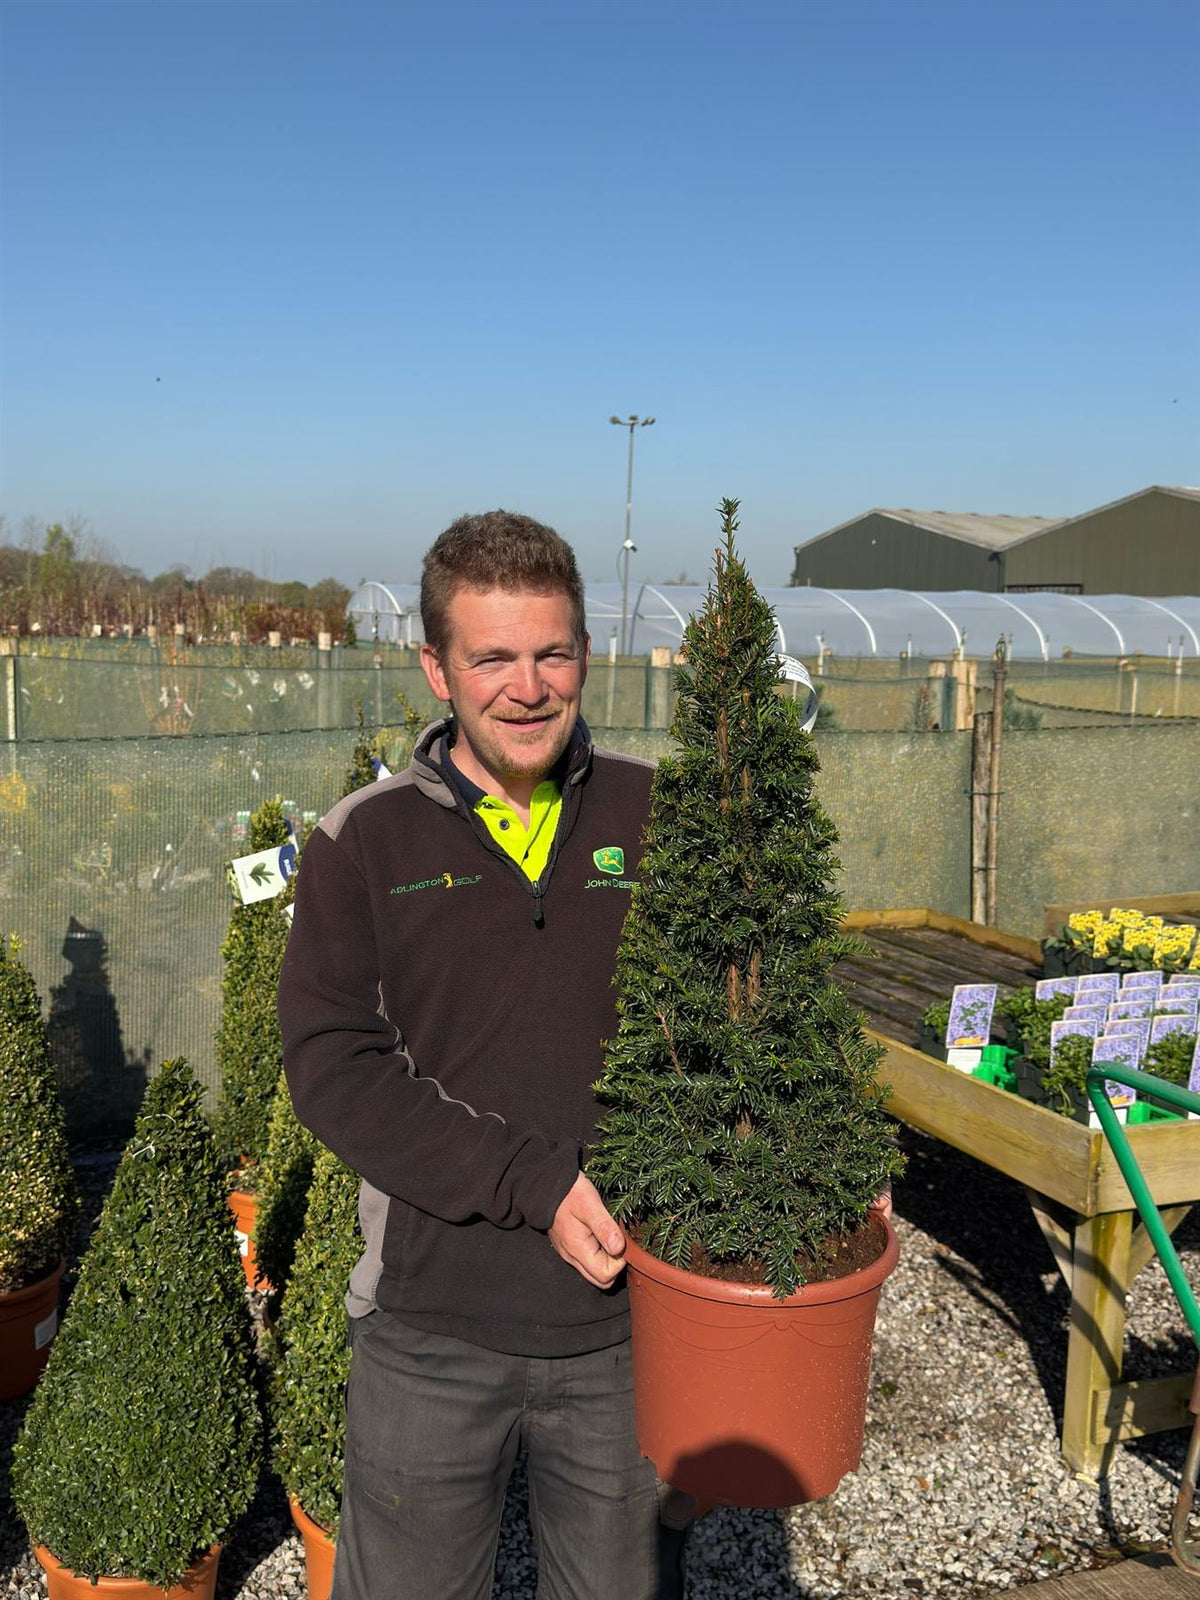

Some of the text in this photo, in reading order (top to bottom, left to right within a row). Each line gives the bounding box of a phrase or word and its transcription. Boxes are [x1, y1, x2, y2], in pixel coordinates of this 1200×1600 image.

[389, 874, 483, 895] ADLINGTON GOLF
[584, 878, 612, 889] JOHN
